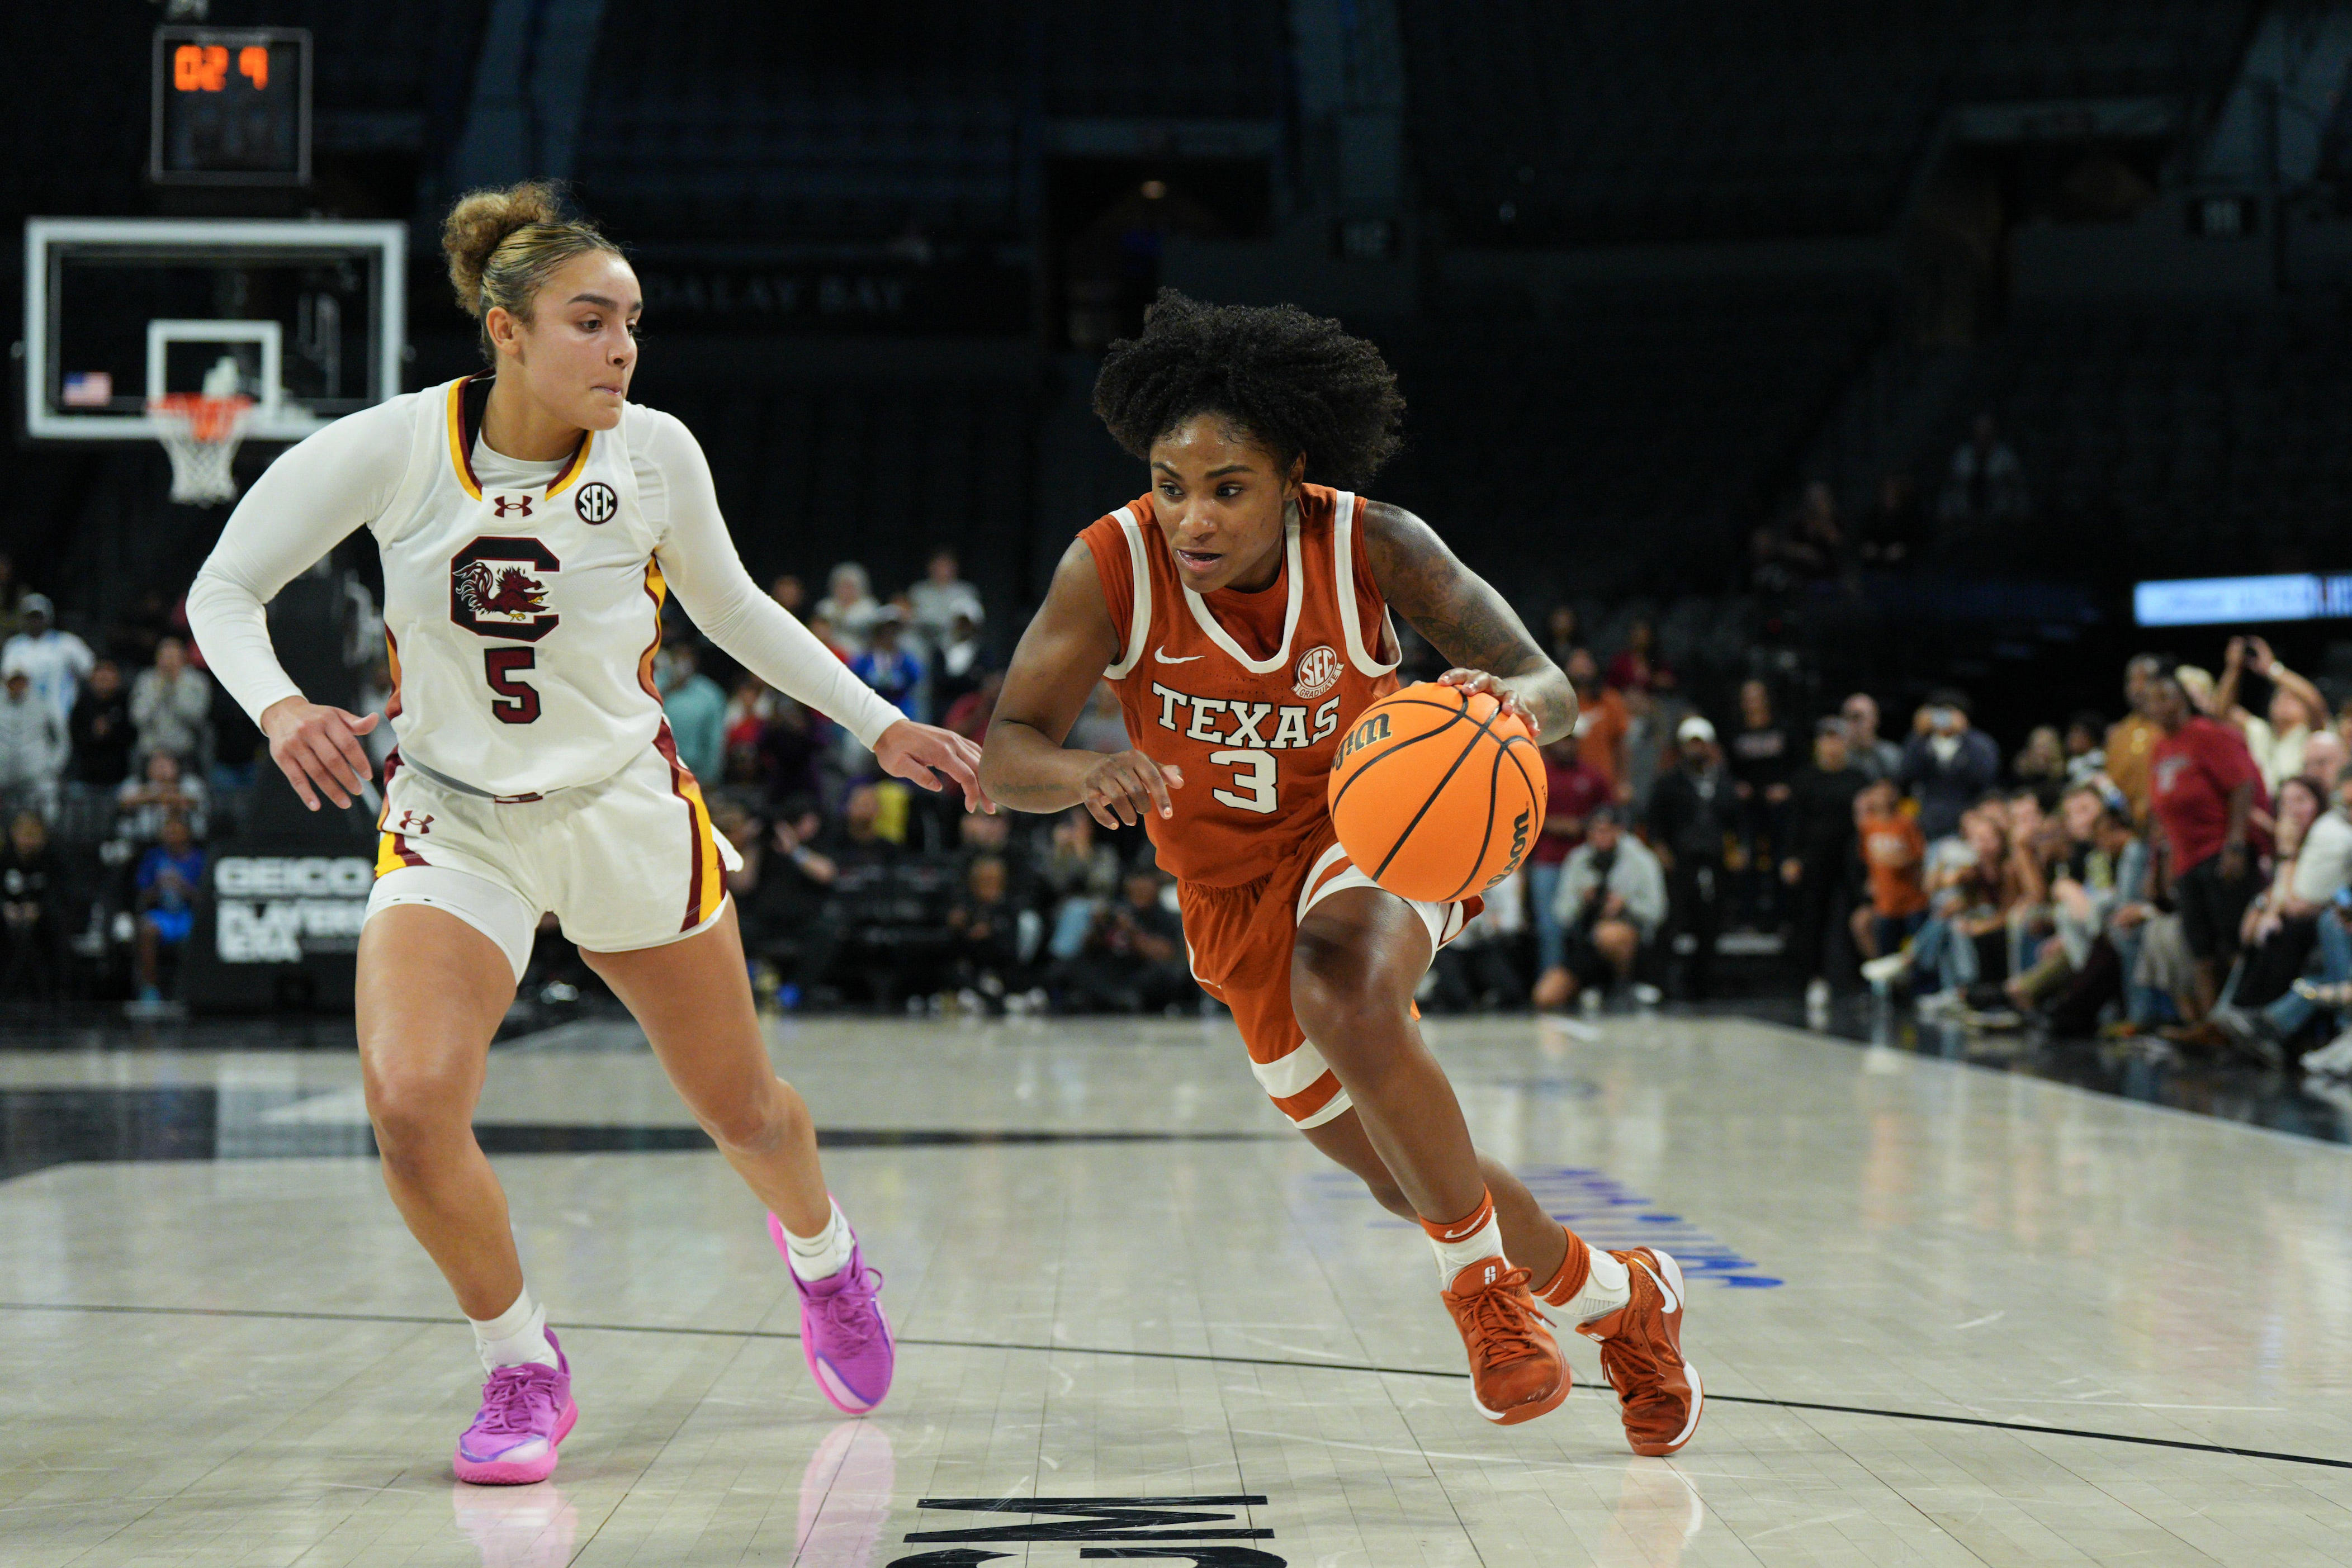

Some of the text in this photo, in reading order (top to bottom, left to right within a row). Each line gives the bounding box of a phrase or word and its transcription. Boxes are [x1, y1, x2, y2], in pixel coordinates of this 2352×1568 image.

[579, 485, 614, 522] SEC
[484, 646, 541, 724] 5
[1299, 673, 1339, 698] GRADUATE
[1302, 649, 1333, 687] SEC
[1152, 680, 1341, 749] TEXAS
[1209, 749, 1279, 814] 3
